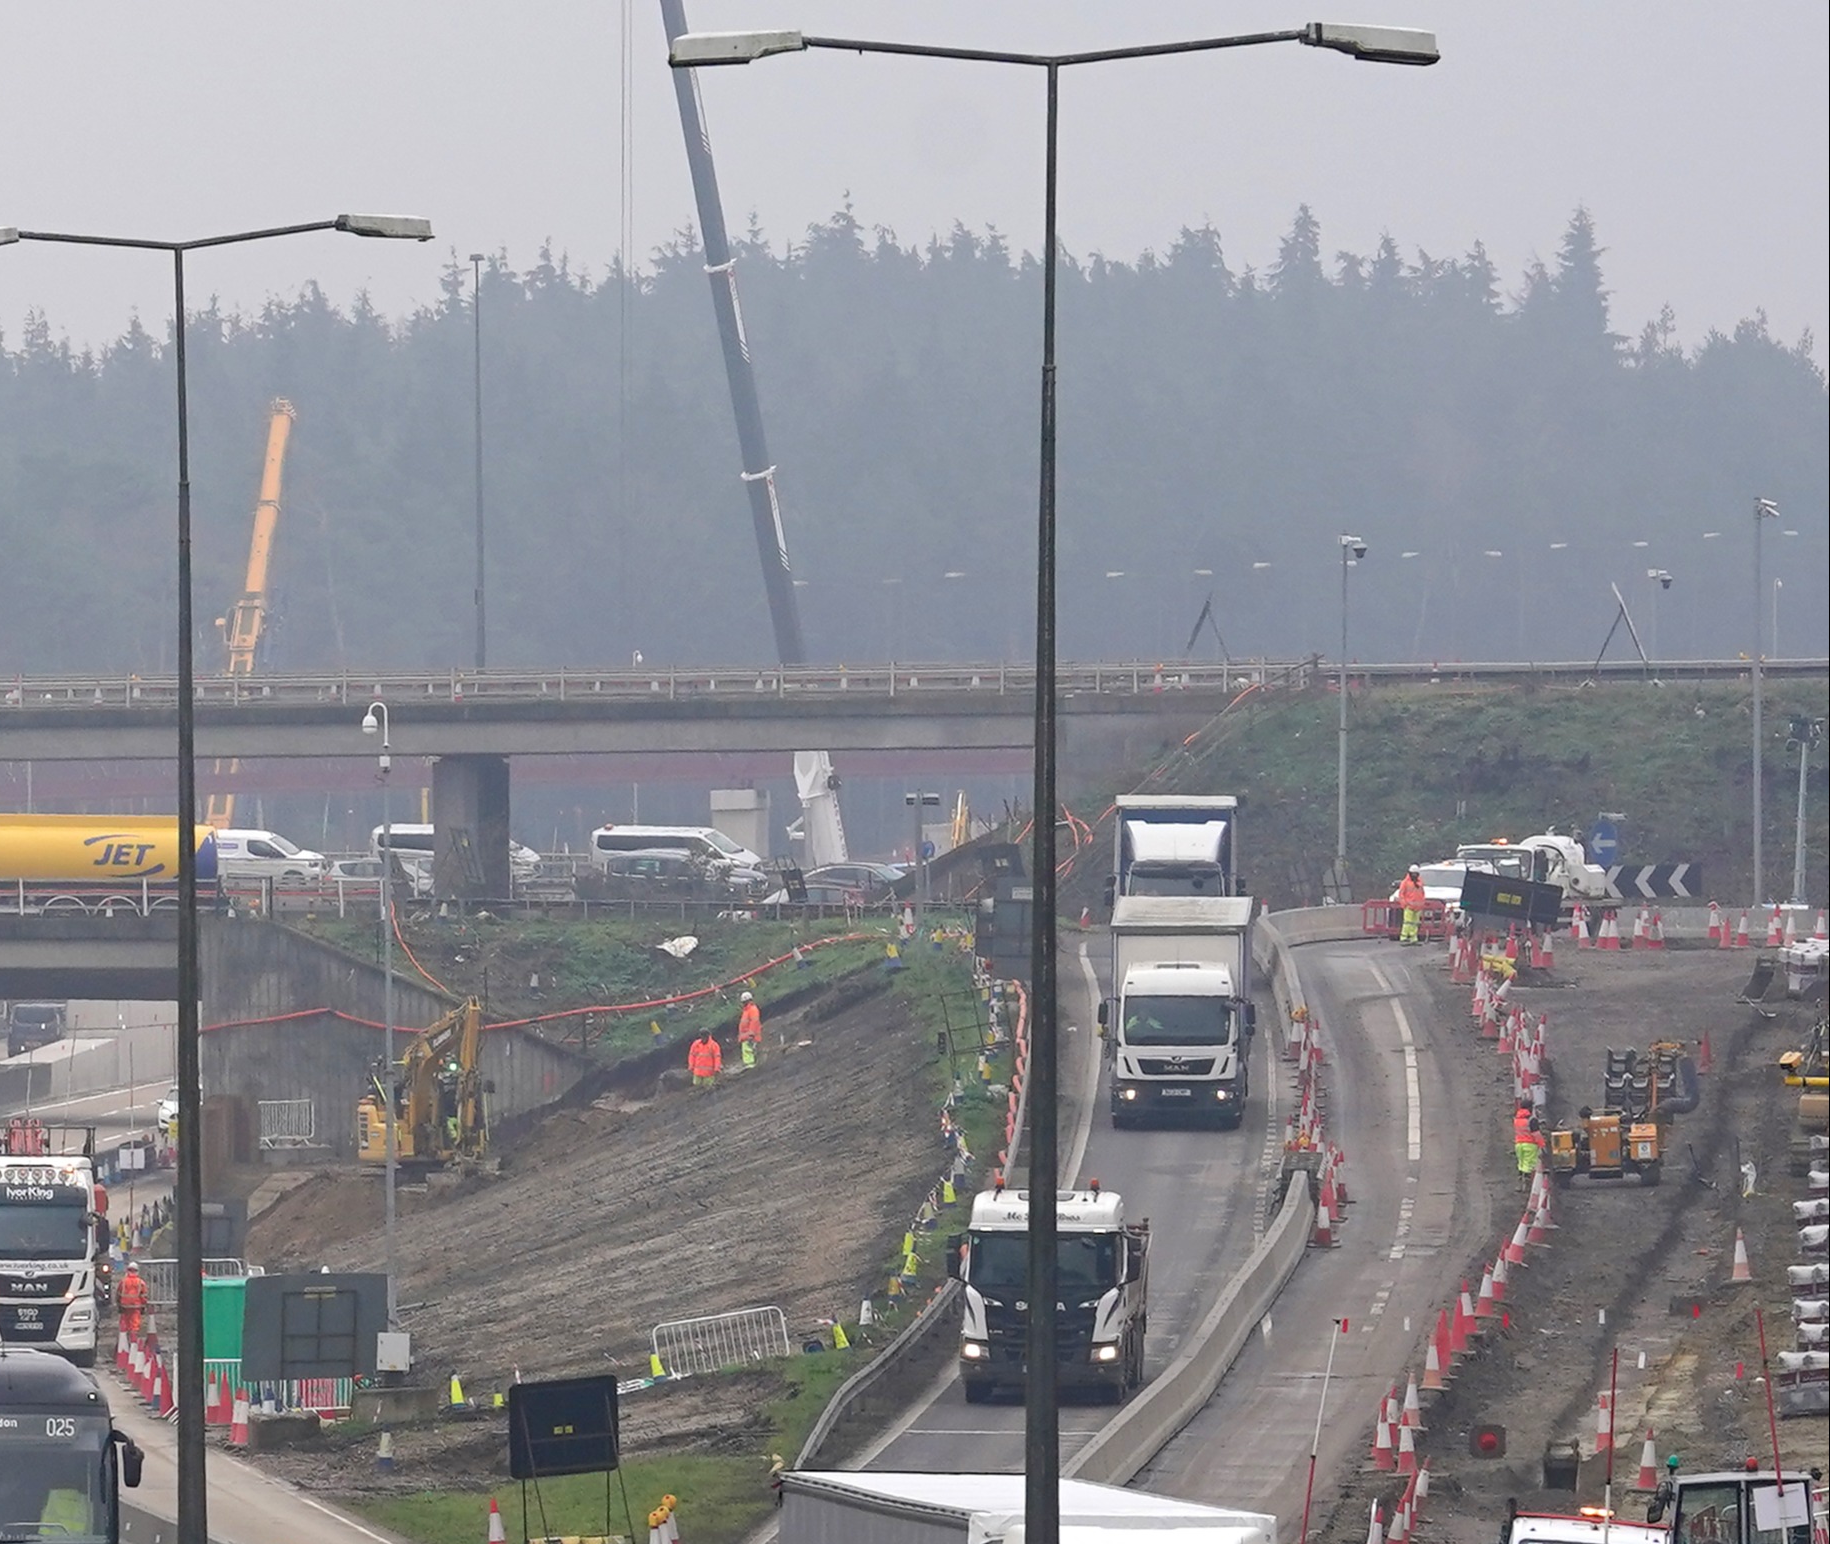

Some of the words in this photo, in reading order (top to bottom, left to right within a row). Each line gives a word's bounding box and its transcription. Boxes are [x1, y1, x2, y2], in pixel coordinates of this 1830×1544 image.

[93, 844, 156, 866] JET
[11, 1282, 47, 1291] MAN
[46, 1418, 76, 1437] 025
